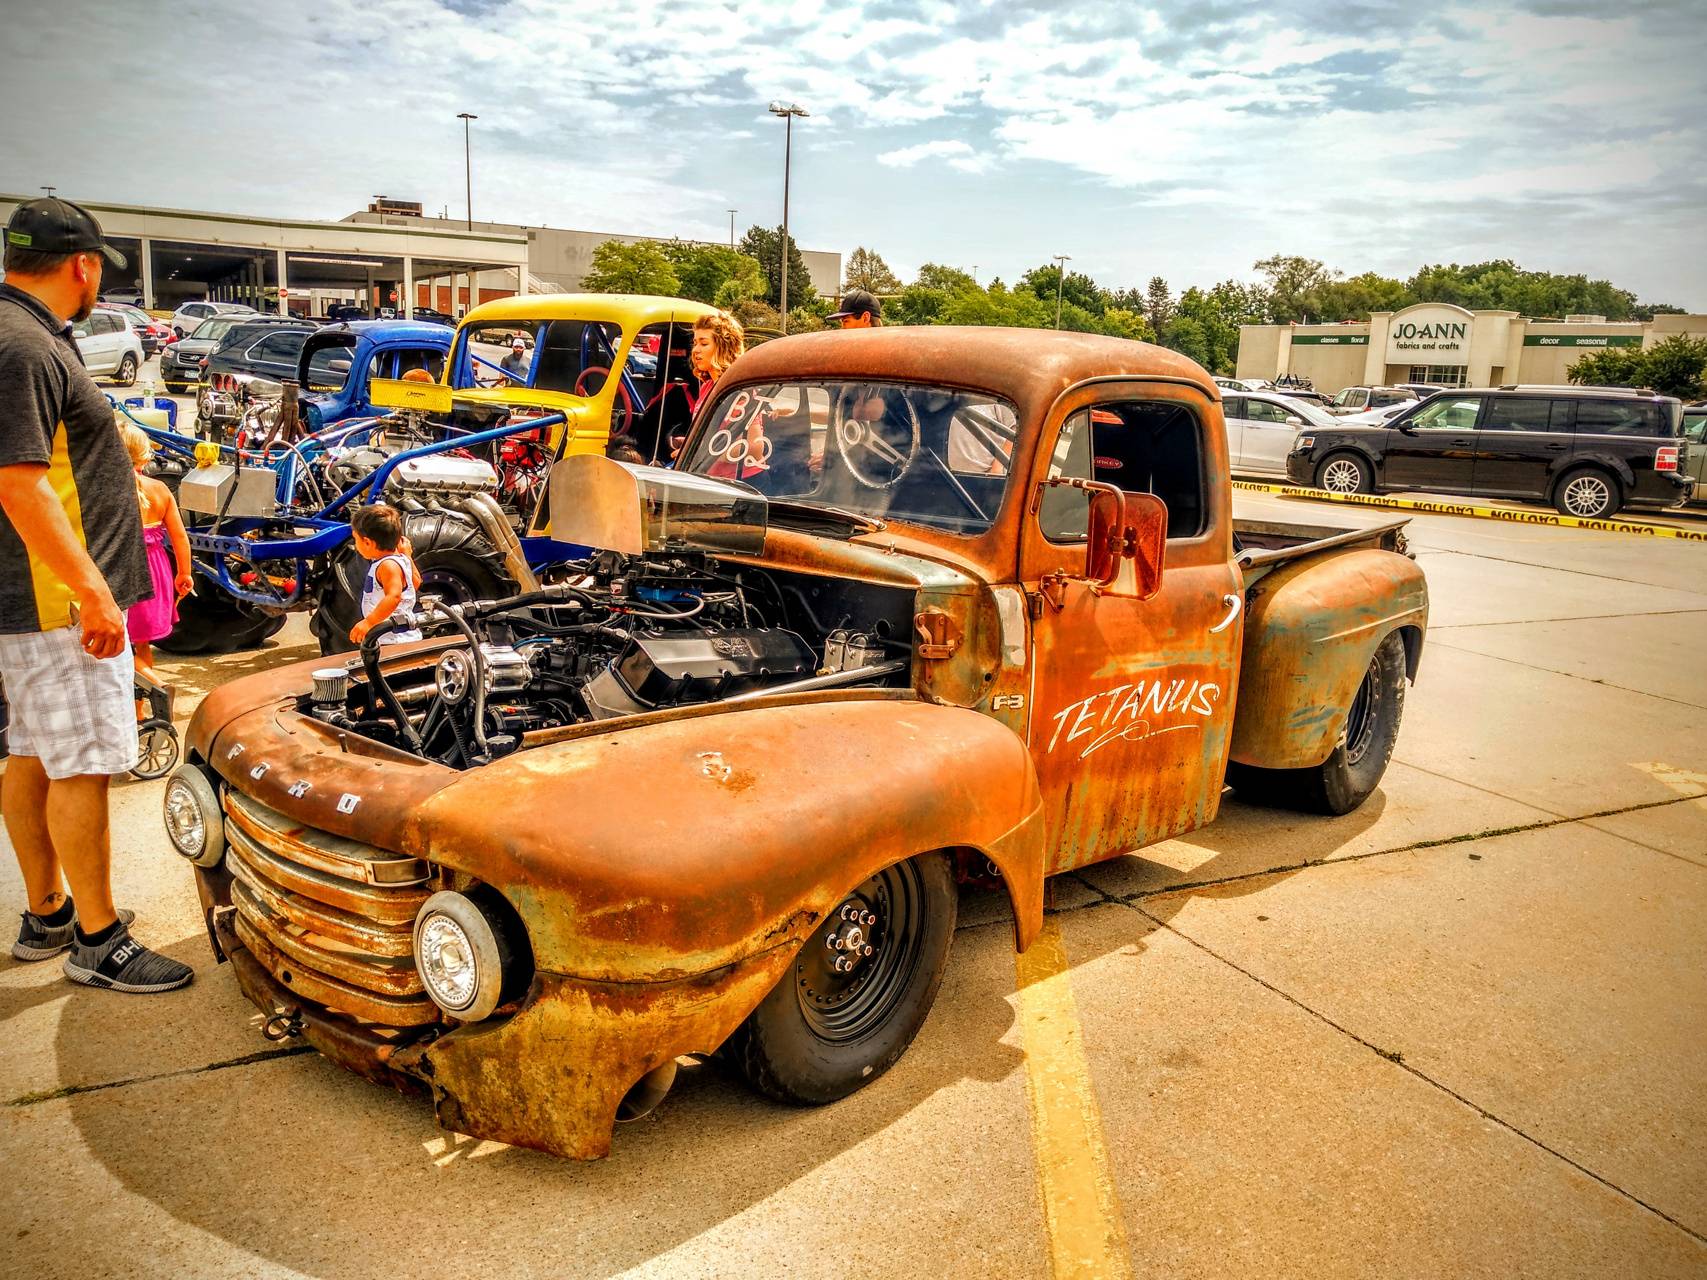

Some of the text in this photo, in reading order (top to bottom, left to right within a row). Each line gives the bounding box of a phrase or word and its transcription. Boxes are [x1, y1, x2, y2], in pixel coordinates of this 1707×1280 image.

[1350, 336, 1365, 344] floral
[1539, 337, 1608, 346] decor seasonal
[1396, 341, 1460, 351] fabrics and crafts
[1047, 679, 1221, 754] TETANUS
